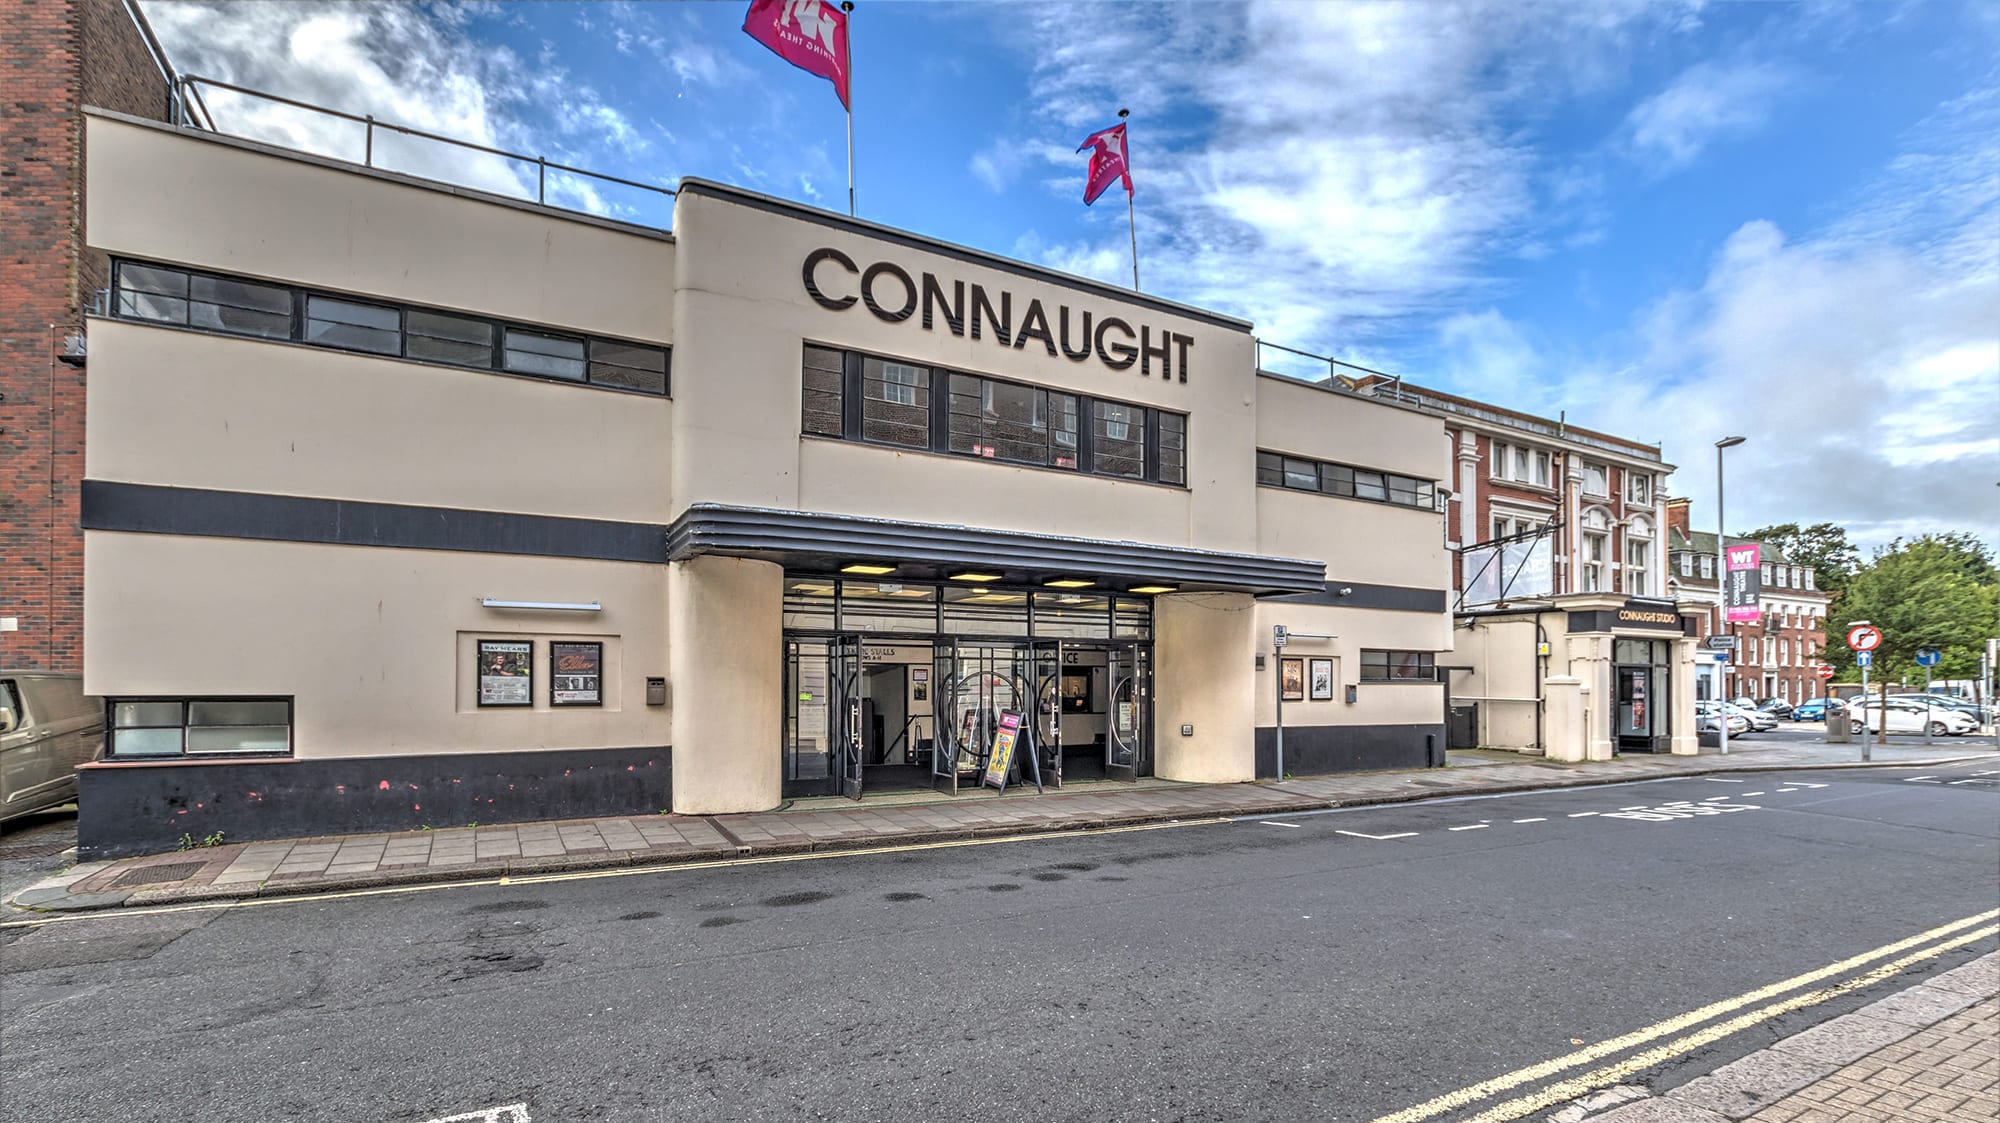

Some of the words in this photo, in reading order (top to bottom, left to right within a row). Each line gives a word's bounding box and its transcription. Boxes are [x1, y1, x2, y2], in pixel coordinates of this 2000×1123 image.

[802, 247, 1195, 384] CONNAUGHT
[1731, 550, 1755, 564] WT
[1619, 610, 1655, 622] CONNAUGHT
[1656, 613, 1676, 624] STUDIO
[1043, 652, 1079, 664] OICE
